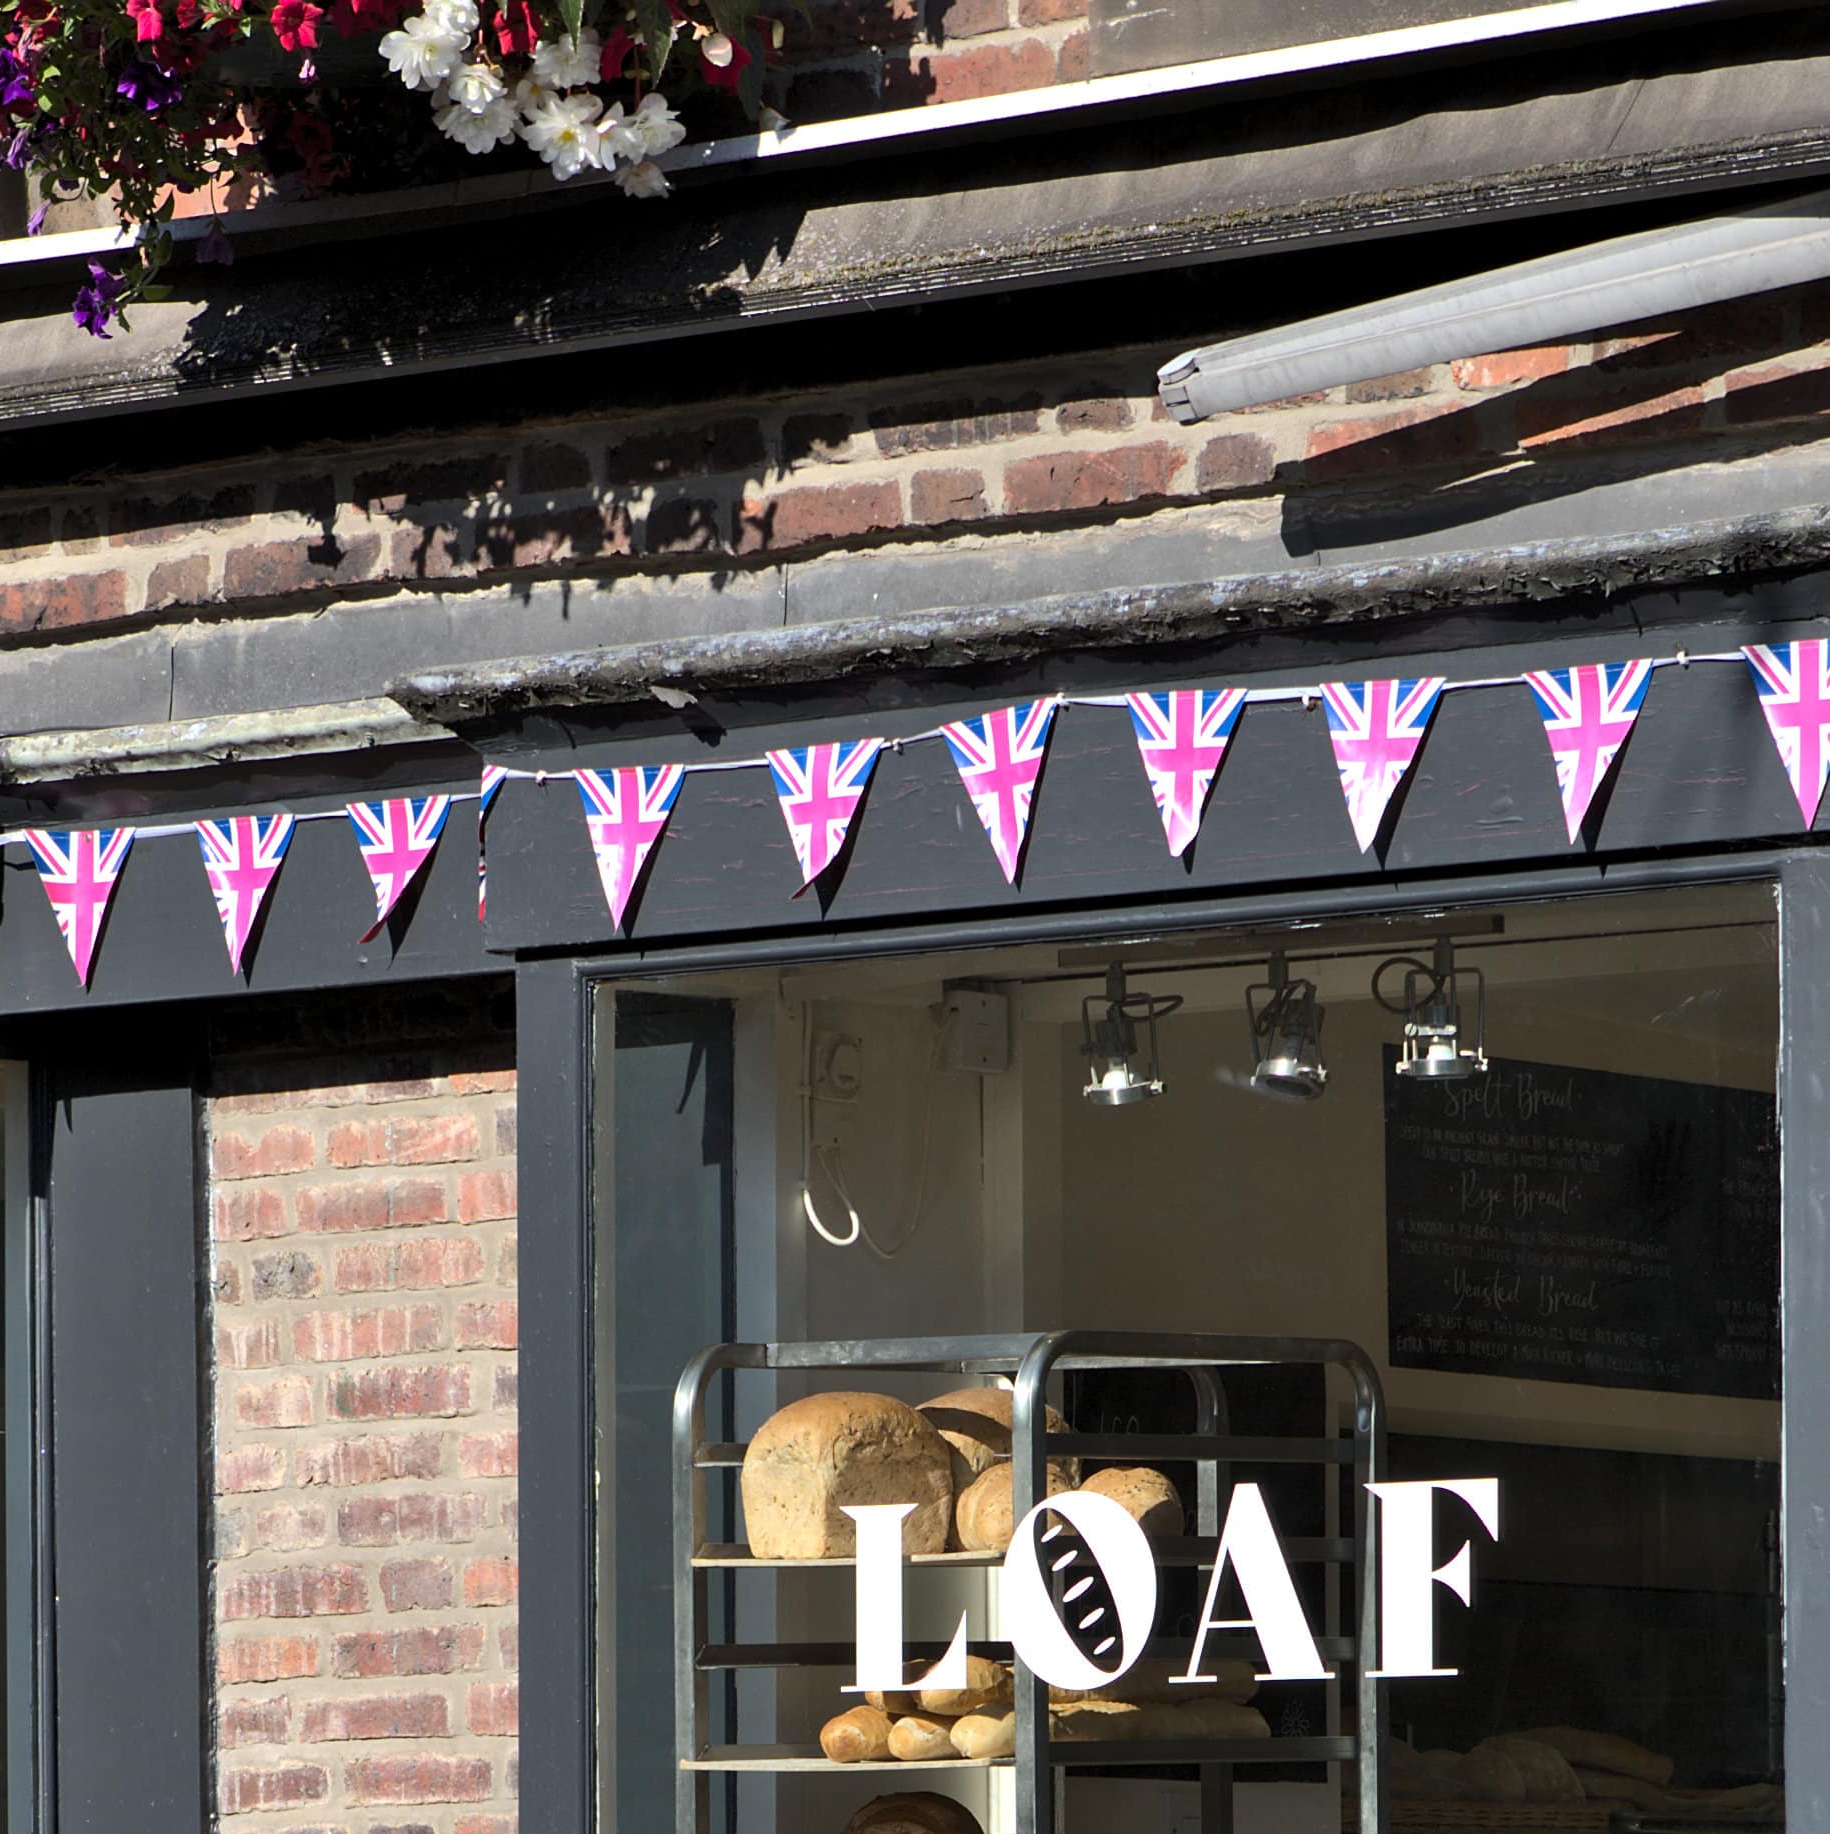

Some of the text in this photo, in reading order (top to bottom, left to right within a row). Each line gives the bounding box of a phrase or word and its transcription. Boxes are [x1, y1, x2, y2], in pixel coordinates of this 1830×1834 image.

[1443, 1072, 1574, 1121] Spelt Bread
[1461, 1168, 1568, 1223] Rye Bread
[1453, 1267, 1598, 1317] Yeasted Bread
[840, 1478, 1499, 1693] LOAF
